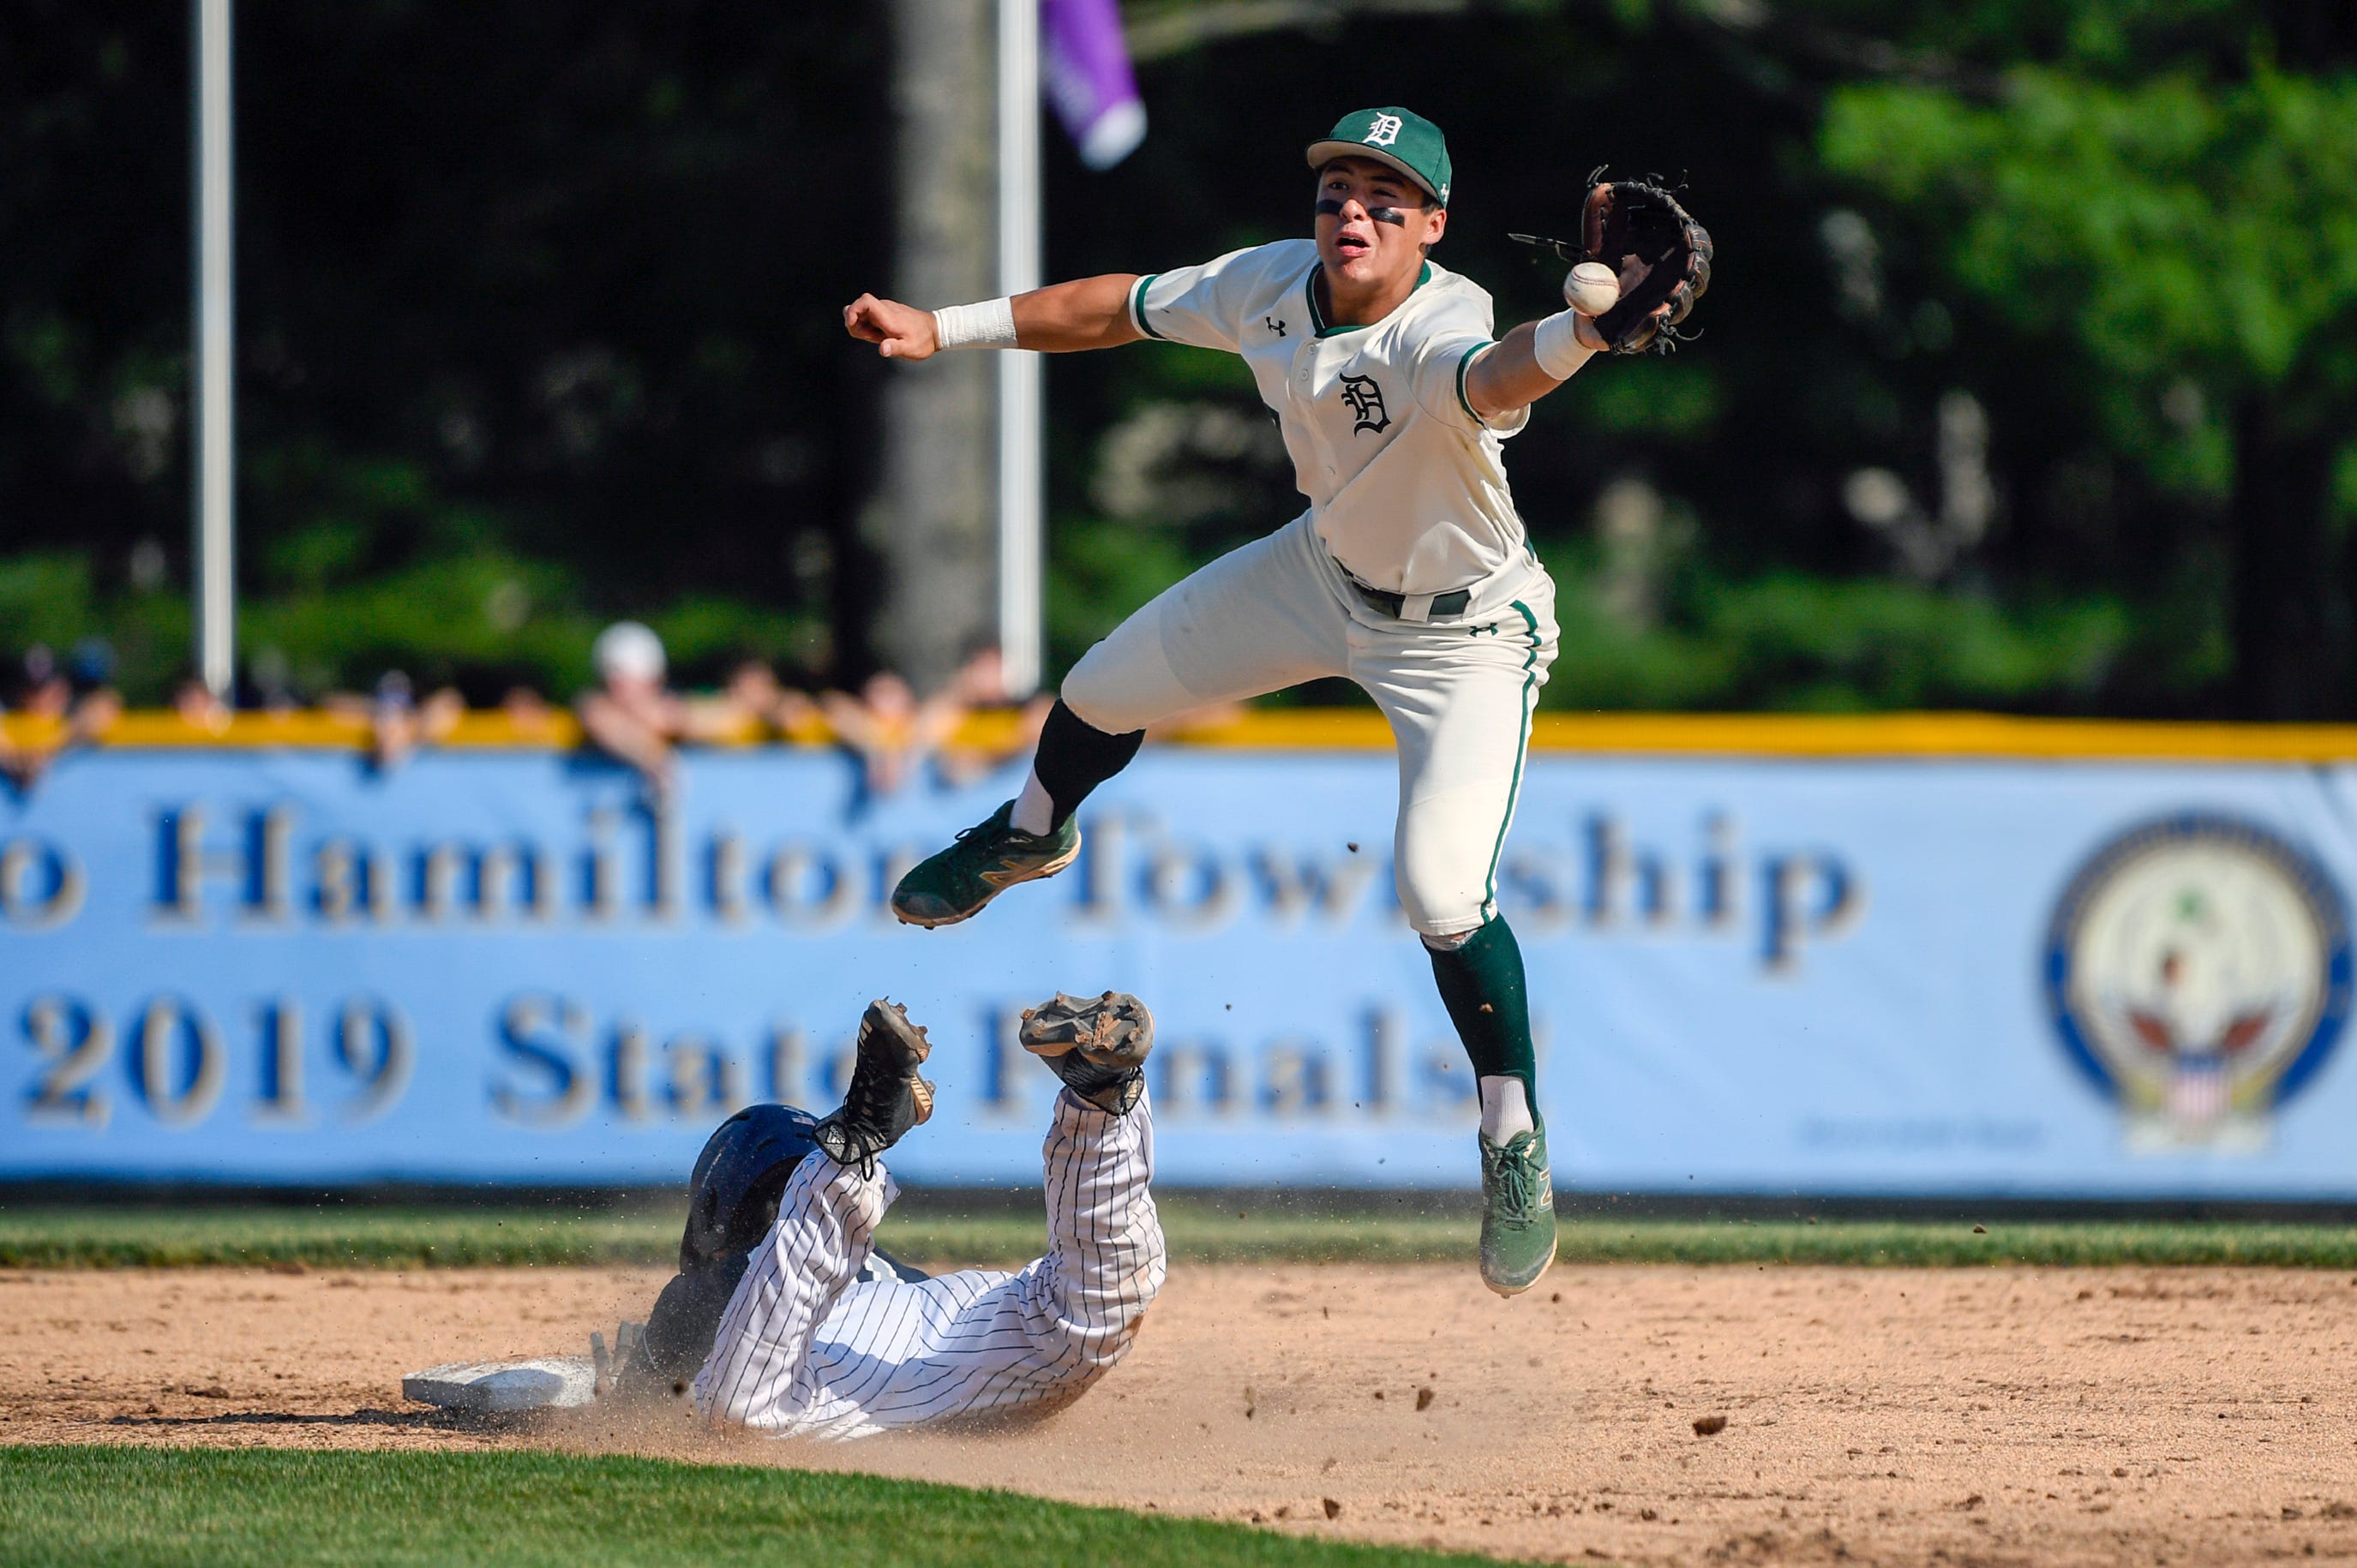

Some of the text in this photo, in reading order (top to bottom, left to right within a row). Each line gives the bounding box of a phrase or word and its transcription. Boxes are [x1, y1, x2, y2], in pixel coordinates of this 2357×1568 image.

[1363, 111, 1403, 146] D
[1339, 372, 1392, 438] D
[1061, 802, 1874, 979] Towship
[21, 992, 415, 1129] 2019
[975, 992, 1488, 1128] Fnals
